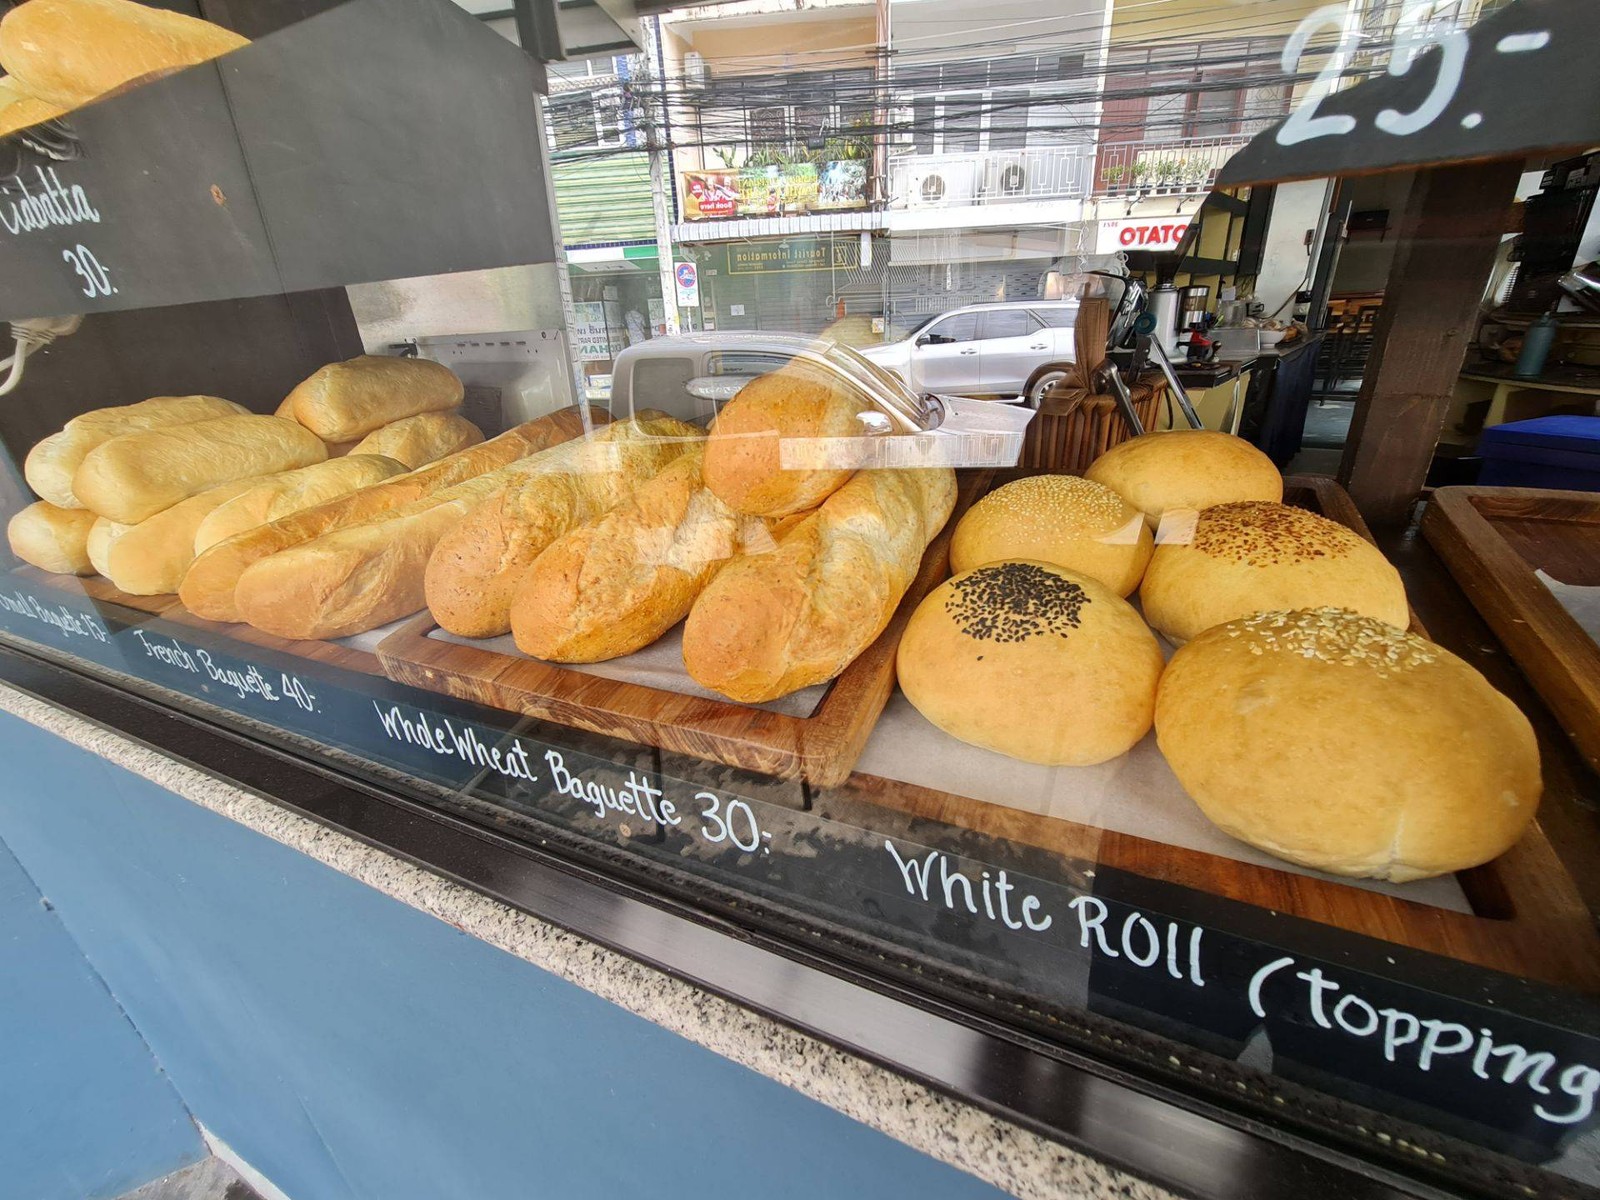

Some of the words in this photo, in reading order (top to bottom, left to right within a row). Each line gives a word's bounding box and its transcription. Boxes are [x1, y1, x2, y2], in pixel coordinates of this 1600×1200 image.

[28, 595, 89, 637] Baguette
[133, 629, 200, 673] French
[196, 649, 280, 700] Baguette
[544, 749, 682, 826] Baguette
[884, 839, 1053, 932] White
